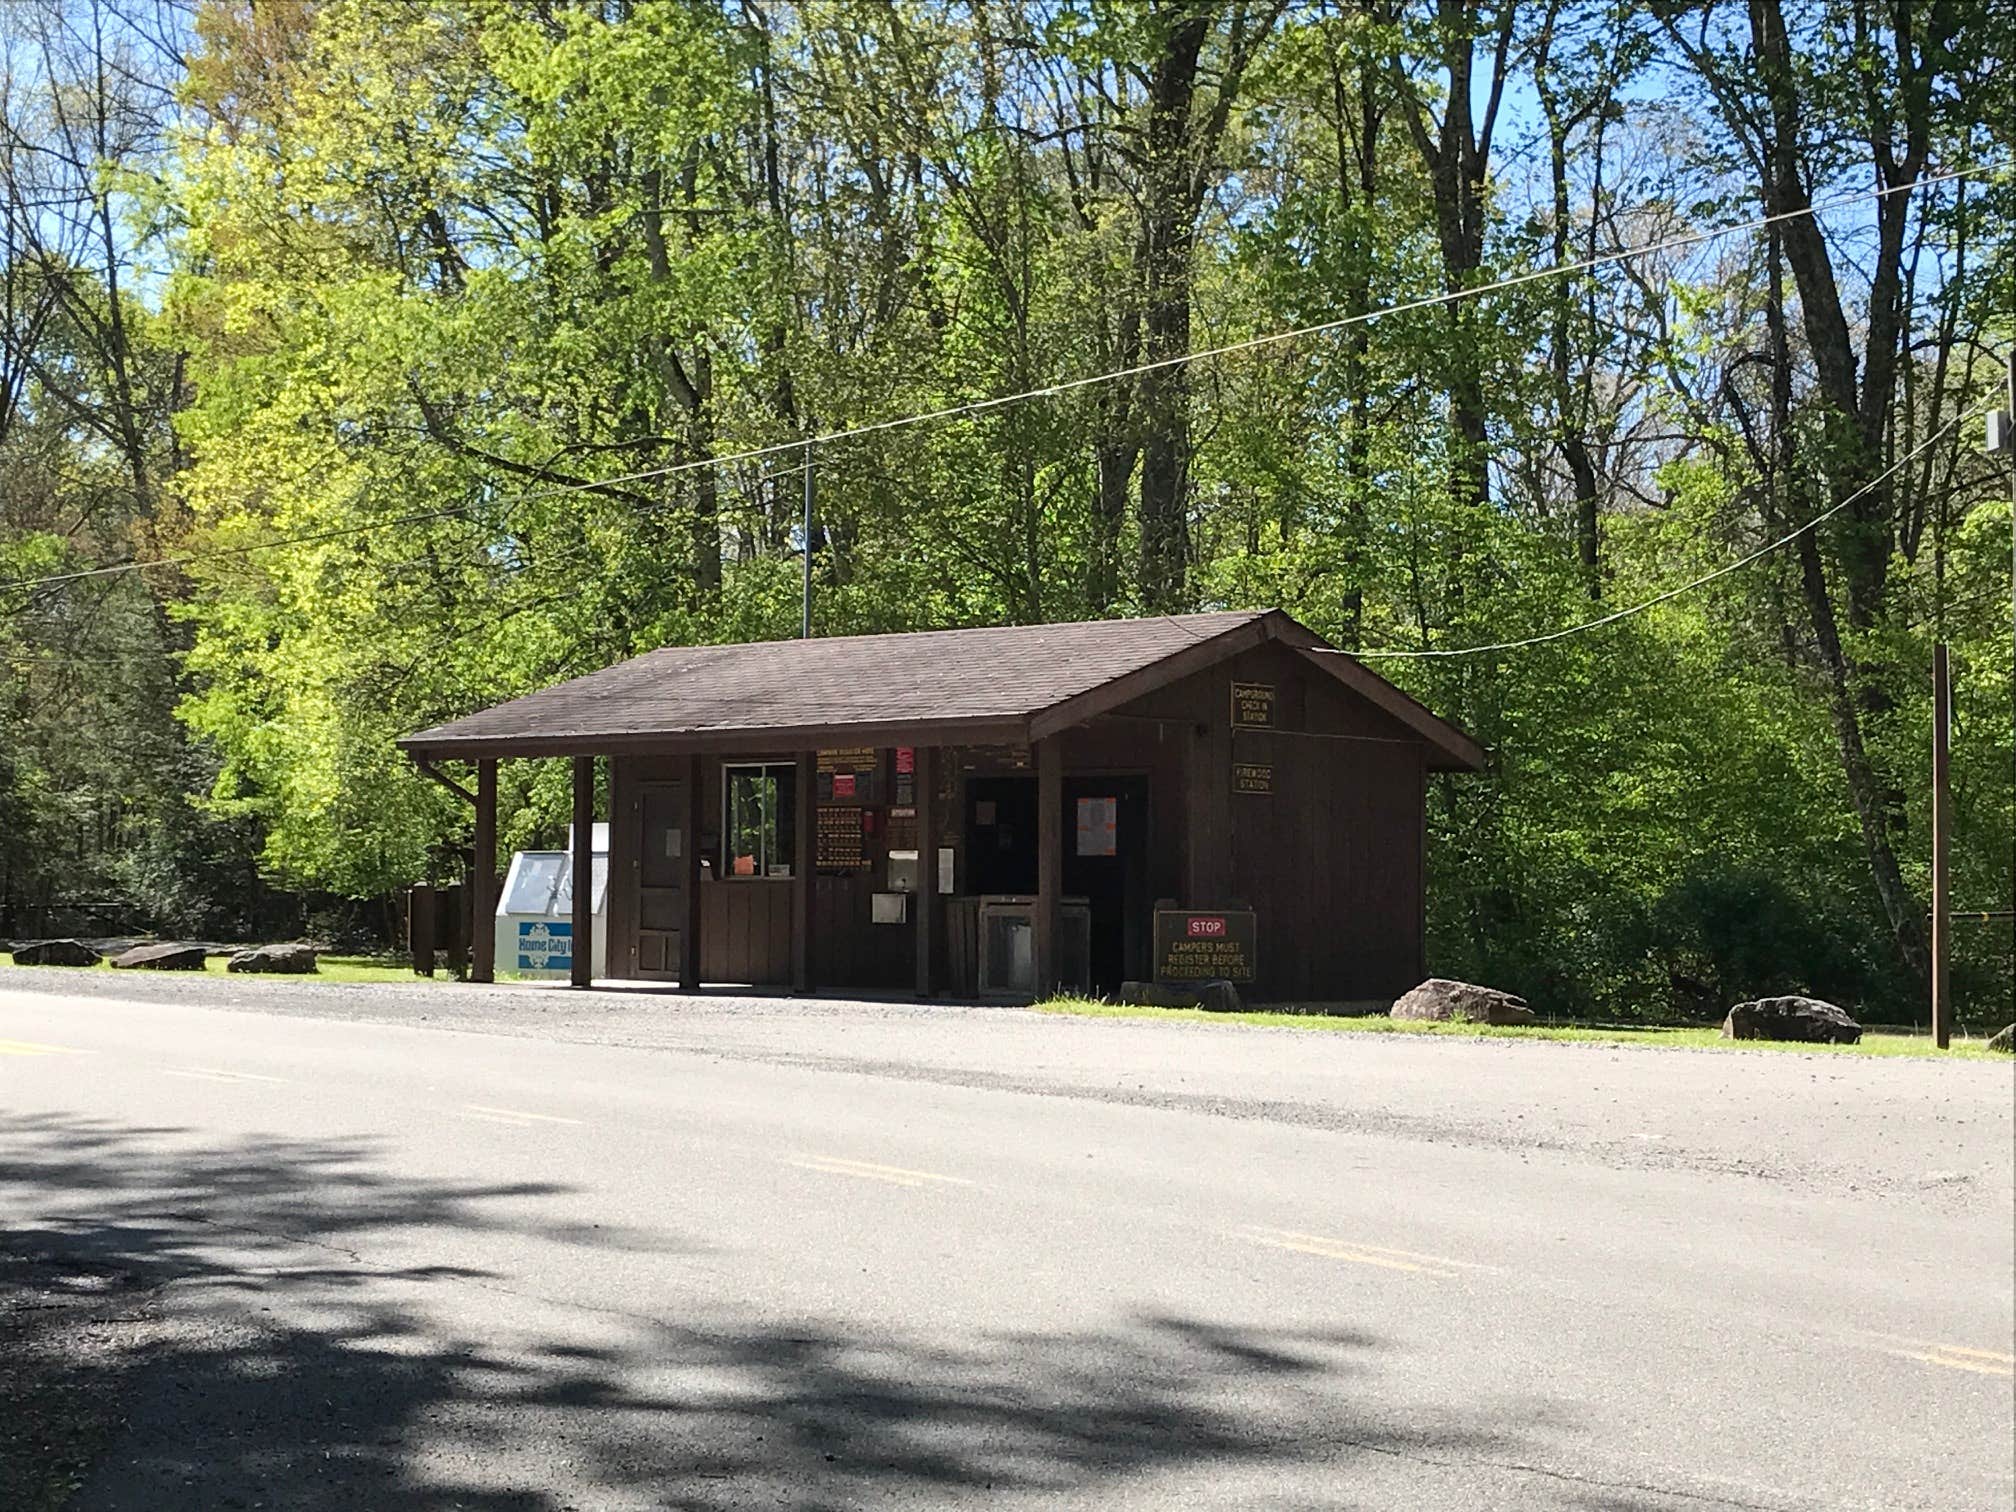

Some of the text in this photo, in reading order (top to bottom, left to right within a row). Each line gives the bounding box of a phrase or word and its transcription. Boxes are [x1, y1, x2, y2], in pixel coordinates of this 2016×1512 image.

[1240, 779, 1269, 790] STATION
[1191, 921, 1222, 933] STOP
[519, 938, 547, 952] Home
[548, 938, 567, 954] City
[1172, 941, 1241, 953] CAMPERS MUST
[1168, 953, 1245, 966] REGISTER BEFORE
[1160, 965, 1252, 977] PROCEEDING TO SITE
